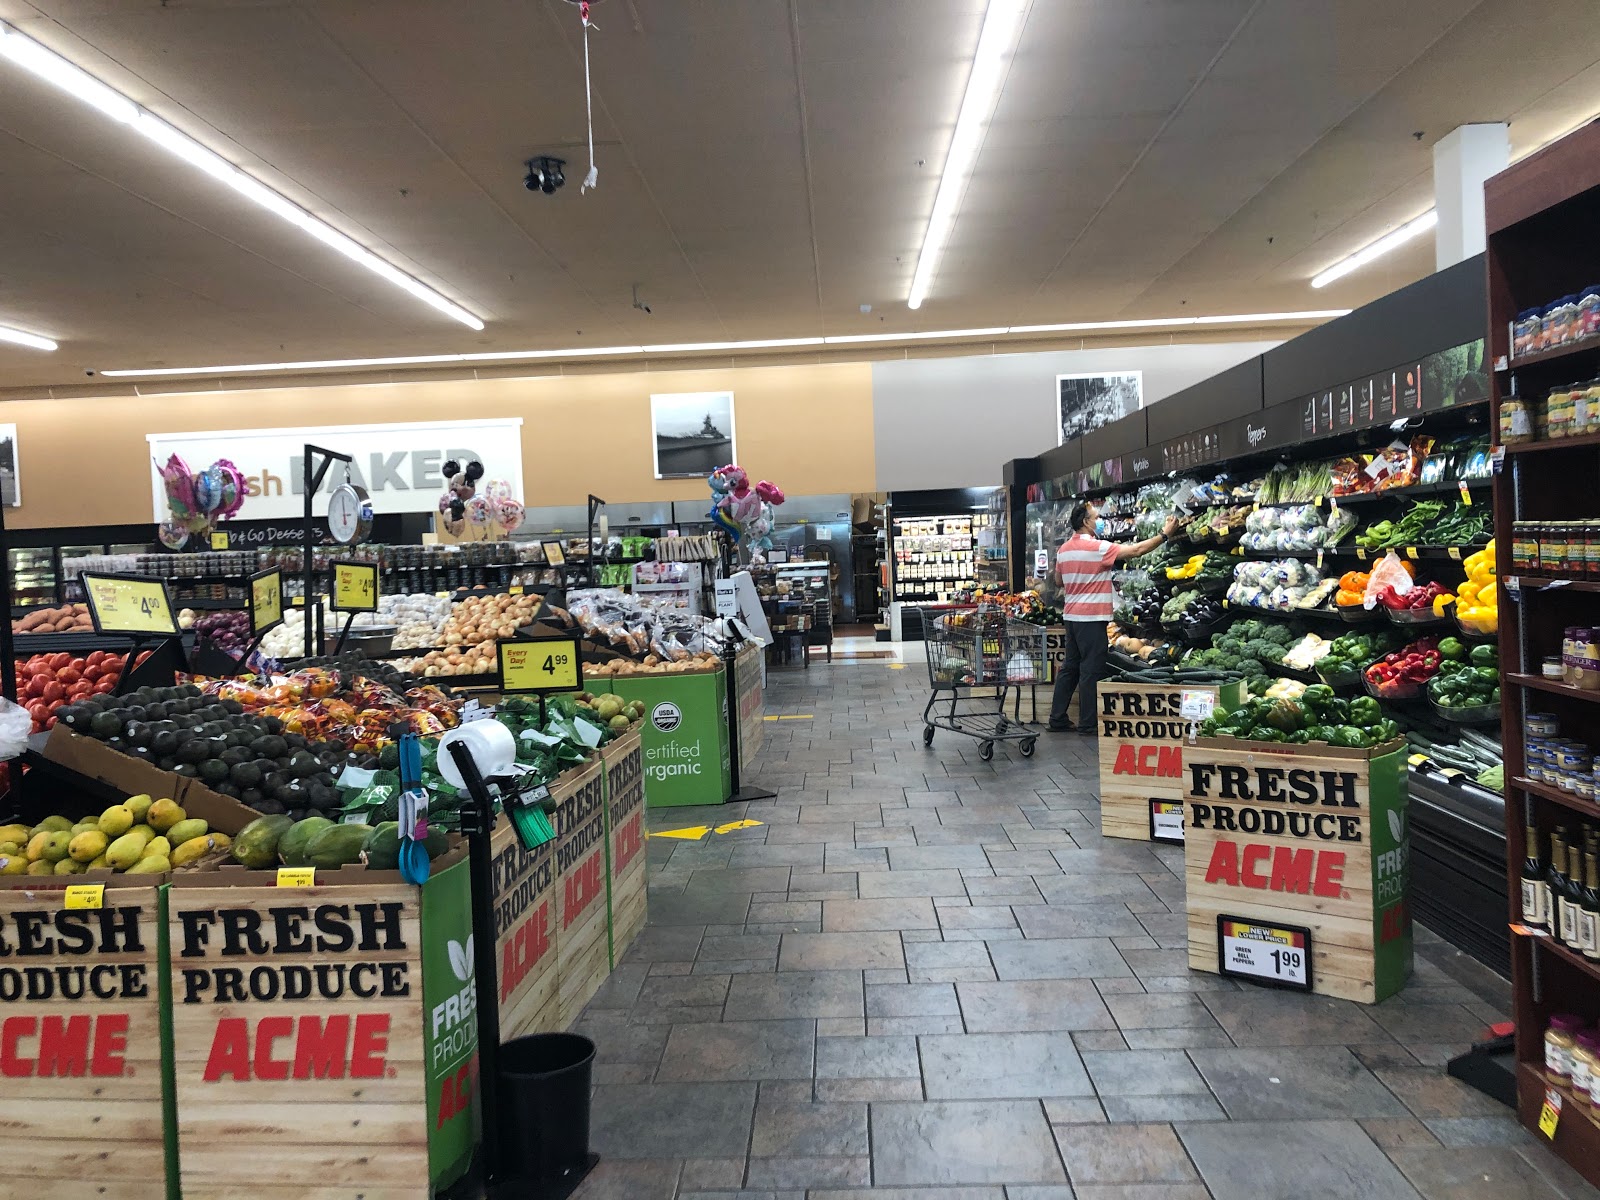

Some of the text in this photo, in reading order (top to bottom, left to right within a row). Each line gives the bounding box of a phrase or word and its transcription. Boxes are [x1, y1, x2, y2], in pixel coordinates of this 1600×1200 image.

[507, 649, 528, 657] Every
[510, 657, 526, 665] Day!
[1101, 692, 1182, 717] FRES
[1103, 720, 1203, 739] PRODUC
[608, 745, 642, 801] FRESH
[646, 739, 700, 760] ertified
[1112, 744, 1183, 778] ACM
[556, 774, 603, 842] FRESH
[609, 780, 643, 832] PRODUCE
[1189, 763, 1361, 808] FRESH
[557, 812, 604, 878] PRODUCE
[615, 811, 643, 880] ACME
[1191, 803, 1362, 842] PRODUCE
[563, 849, 602, 932] ACME
[1204, 840, 1347, 899] ACME
[494, 857, 552, 940] PRODUCE
[0, 906, 145, 957] ESH
[178, 902, 407, 958] FRESH
[501, 899, 550, 1005] ACME
[1234, 946, 1252, 954] GREEN
[1238, 932, 1288, 944] LOWER PRICE
[0, 963, 148, 1001] ODUCE
[182, 961, 411, 1004] PRODUCE
[1232, 957, 1255, 966] PEPPERS
[432, 977, 477, 1040] FRES
[0, 1013, 129, 1078] CME
[202, 1012, 392, 1082] ACME
